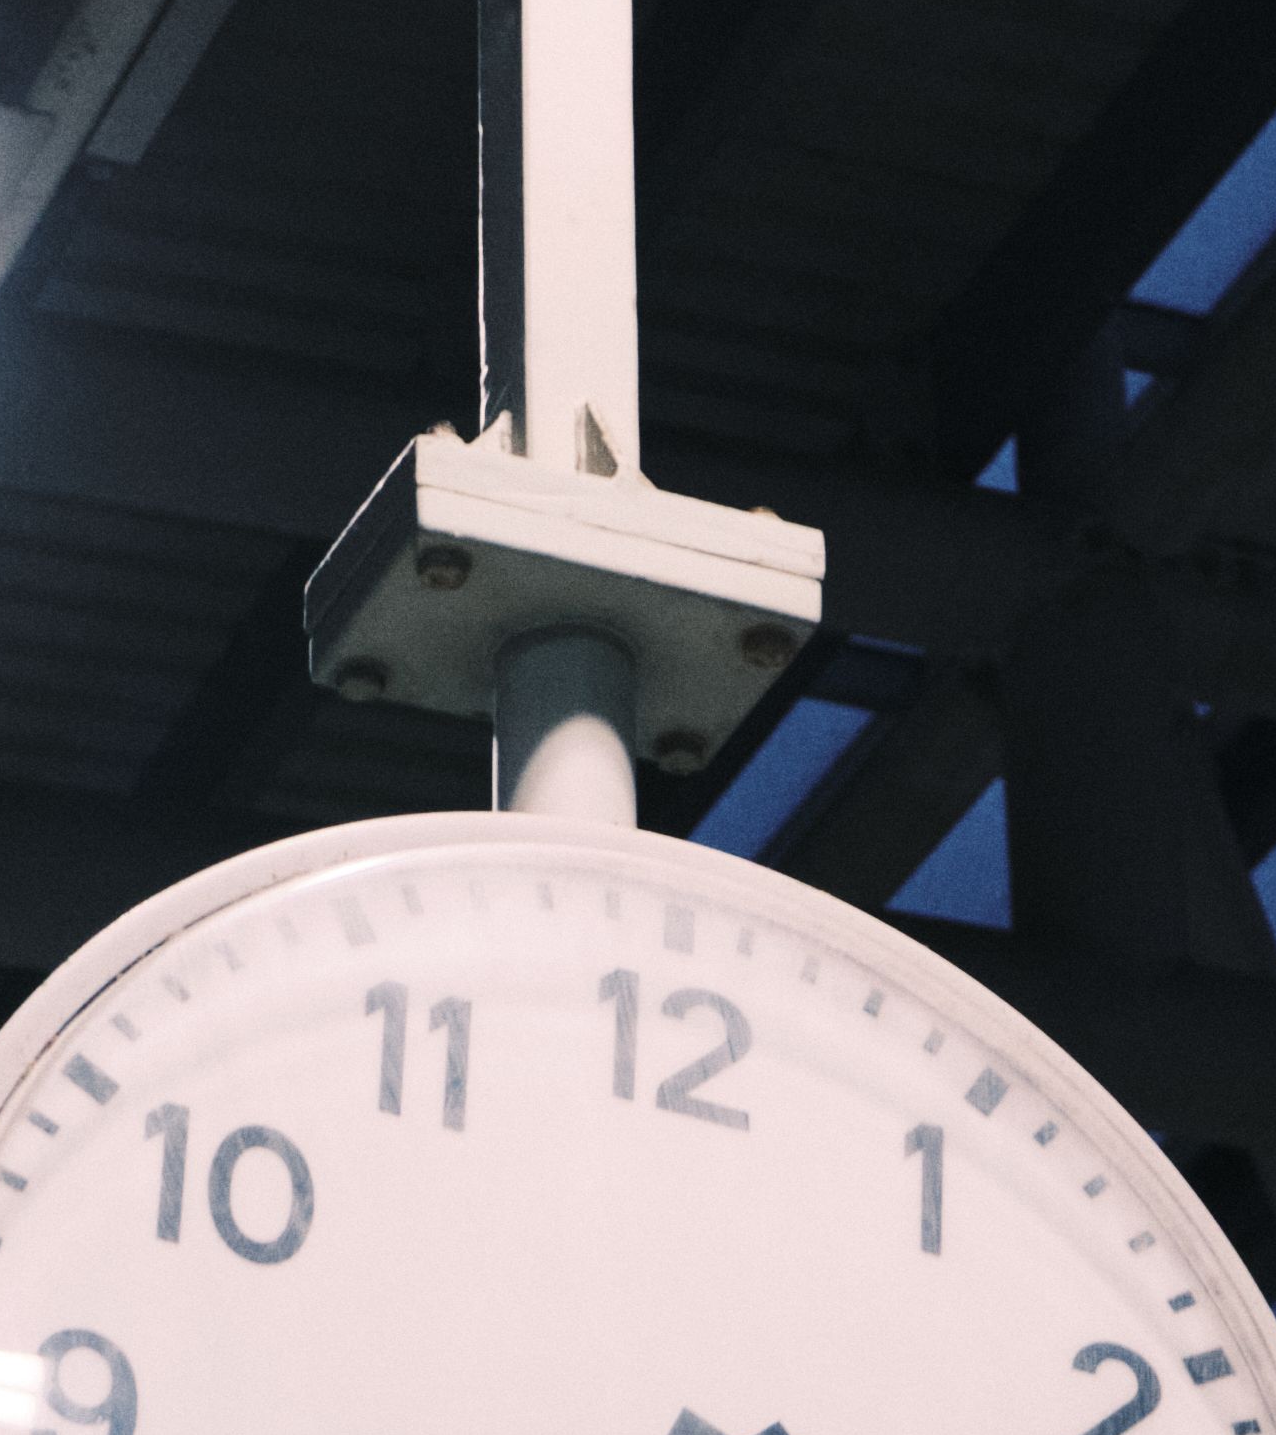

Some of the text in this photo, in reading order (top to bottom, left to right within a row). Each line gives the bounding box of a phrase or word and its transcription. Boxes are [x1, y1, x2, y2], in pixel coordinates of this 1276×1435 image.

[363, 983, 473, 1133] 11
[598, 967, 754, 1132] 12
[142, 1103, 315, 1267] 10
[904, 1122, 947, 1257] 1
